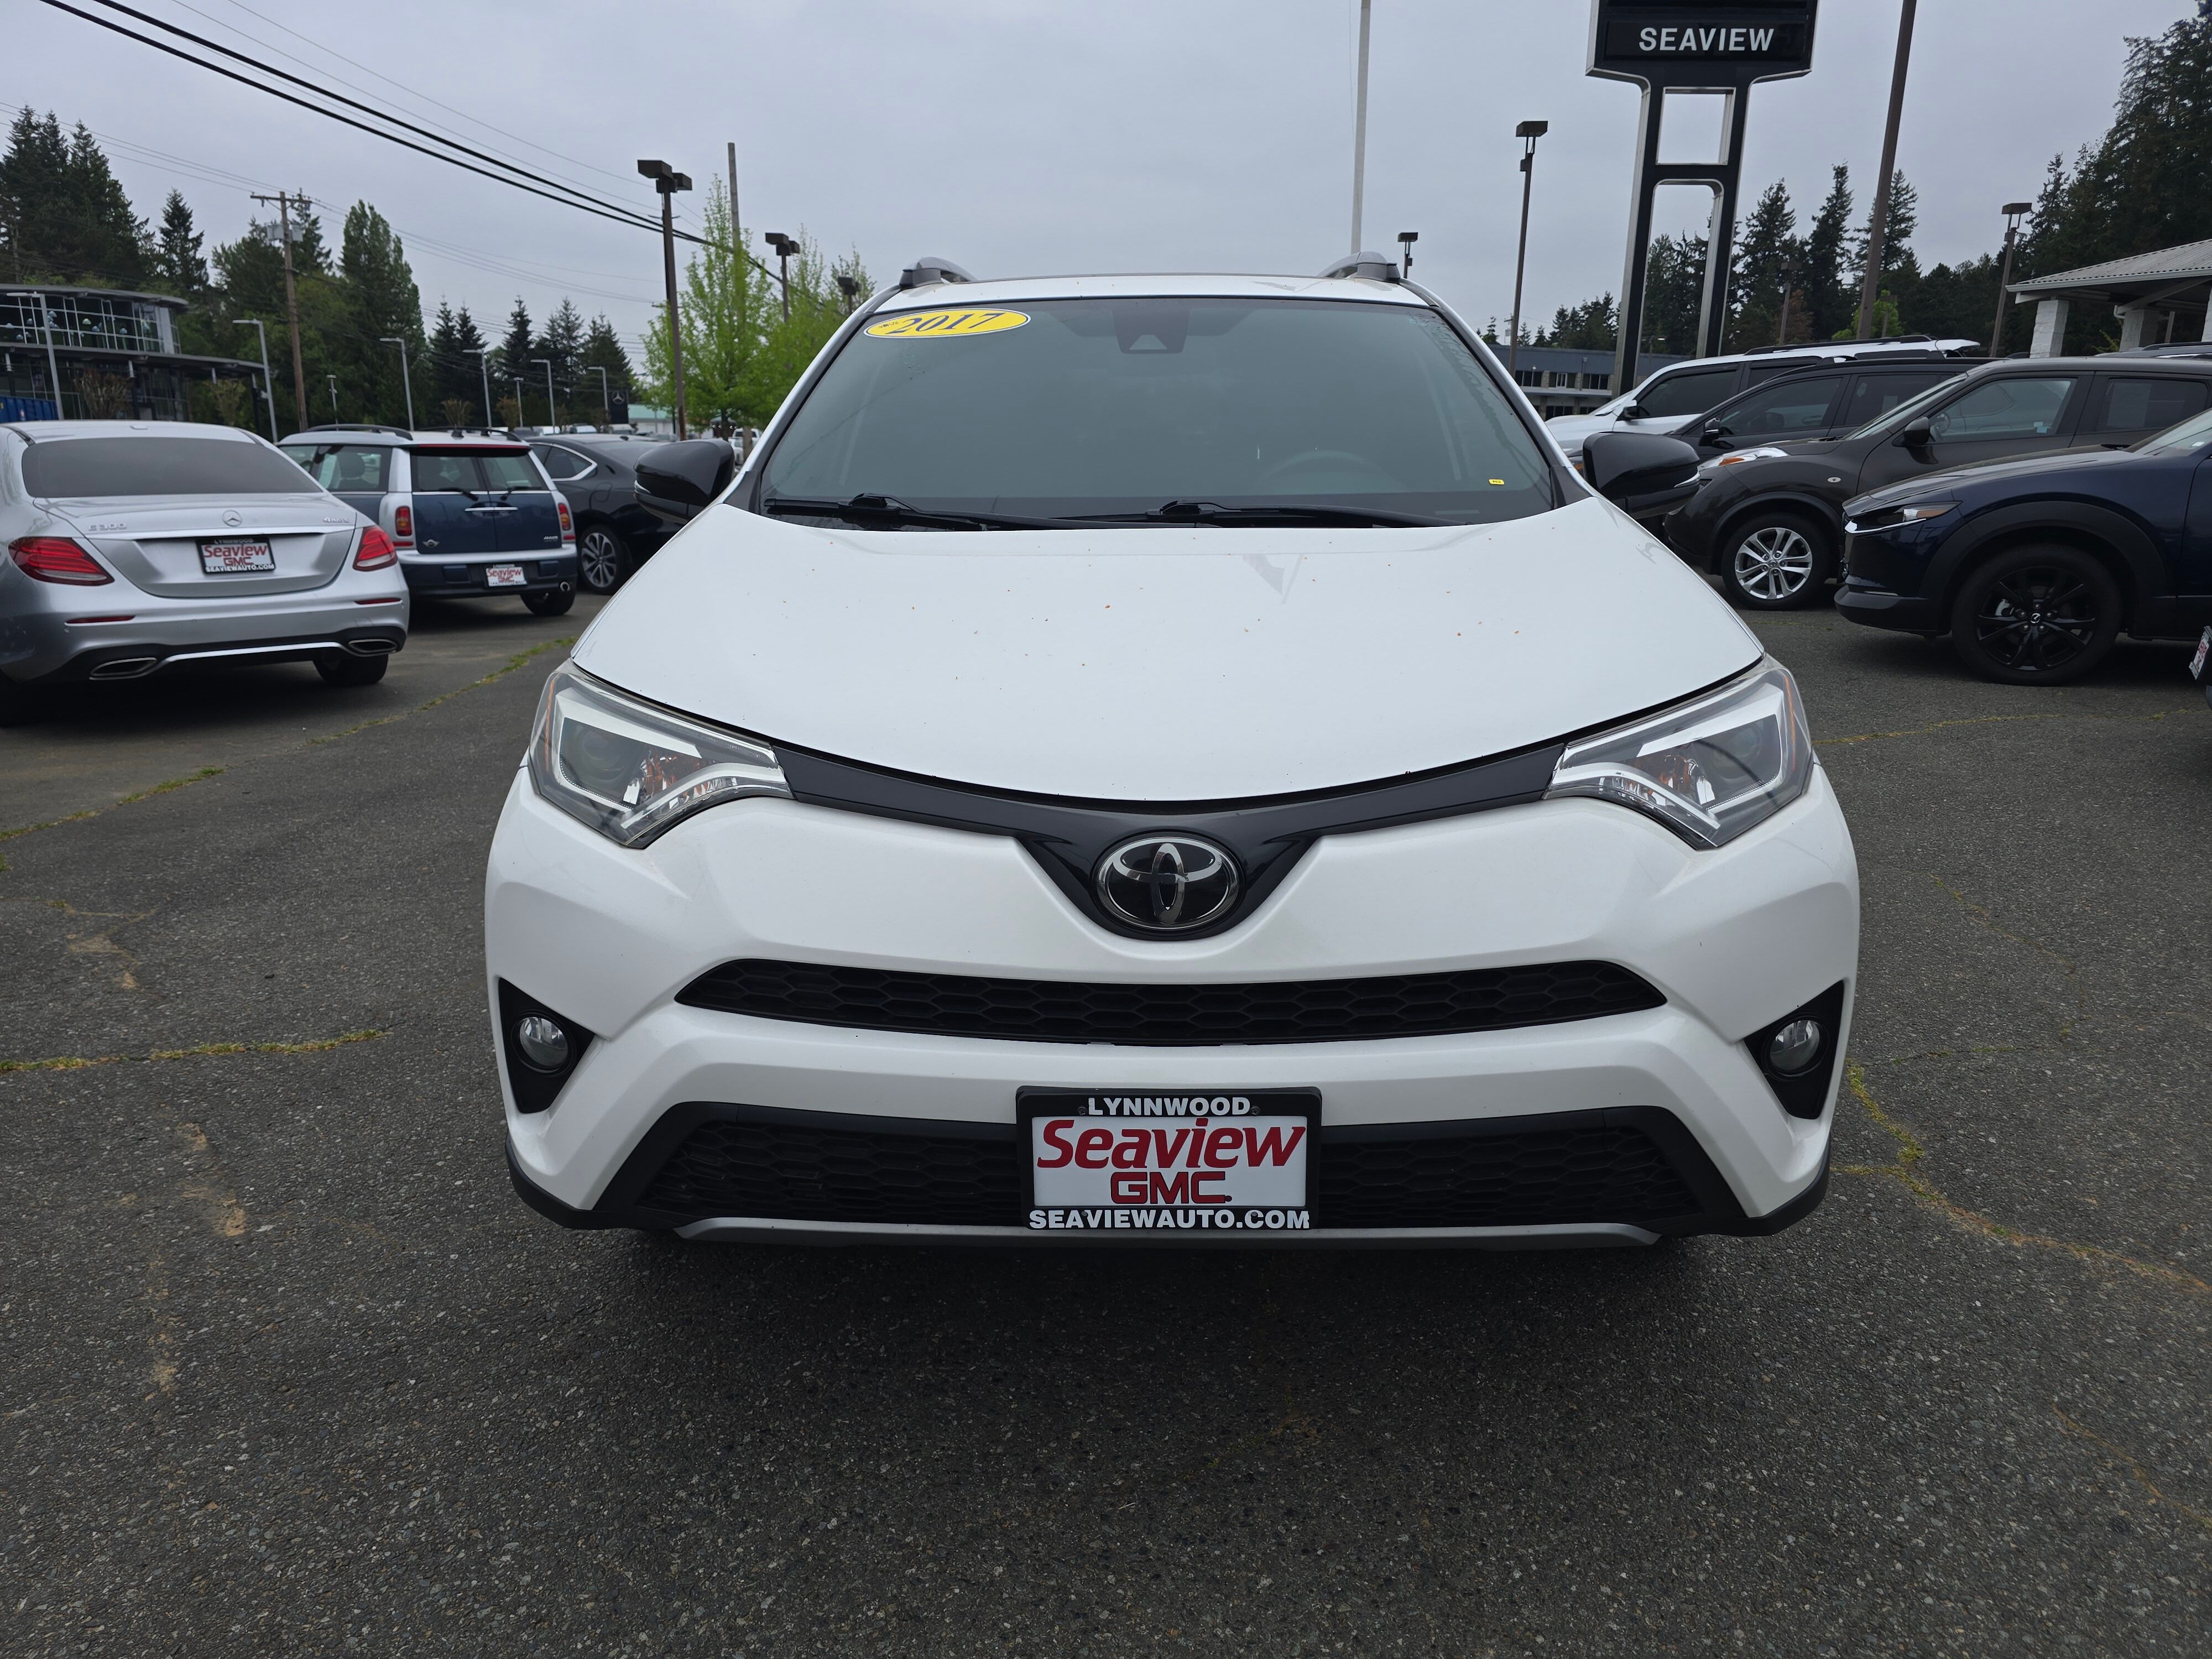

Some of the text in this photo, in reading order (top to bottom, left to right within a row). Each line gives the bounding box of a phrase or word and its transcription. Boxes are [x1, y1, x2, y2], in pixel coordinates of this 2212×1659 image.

[1639, 27, 1775, 51] SEAVIEW
[885, 312, 1006, 335] 2017
[203, 544, 267, 557] Seaview
[223, 557, 254, 566] GMC
[1088, 1097, 1251, 1117] LYNNWOOD
[1036, 1117, 1307, 1169] Seaview
[1029, 1209, 1310, 1229] SEAVIEWAUTO.COM
